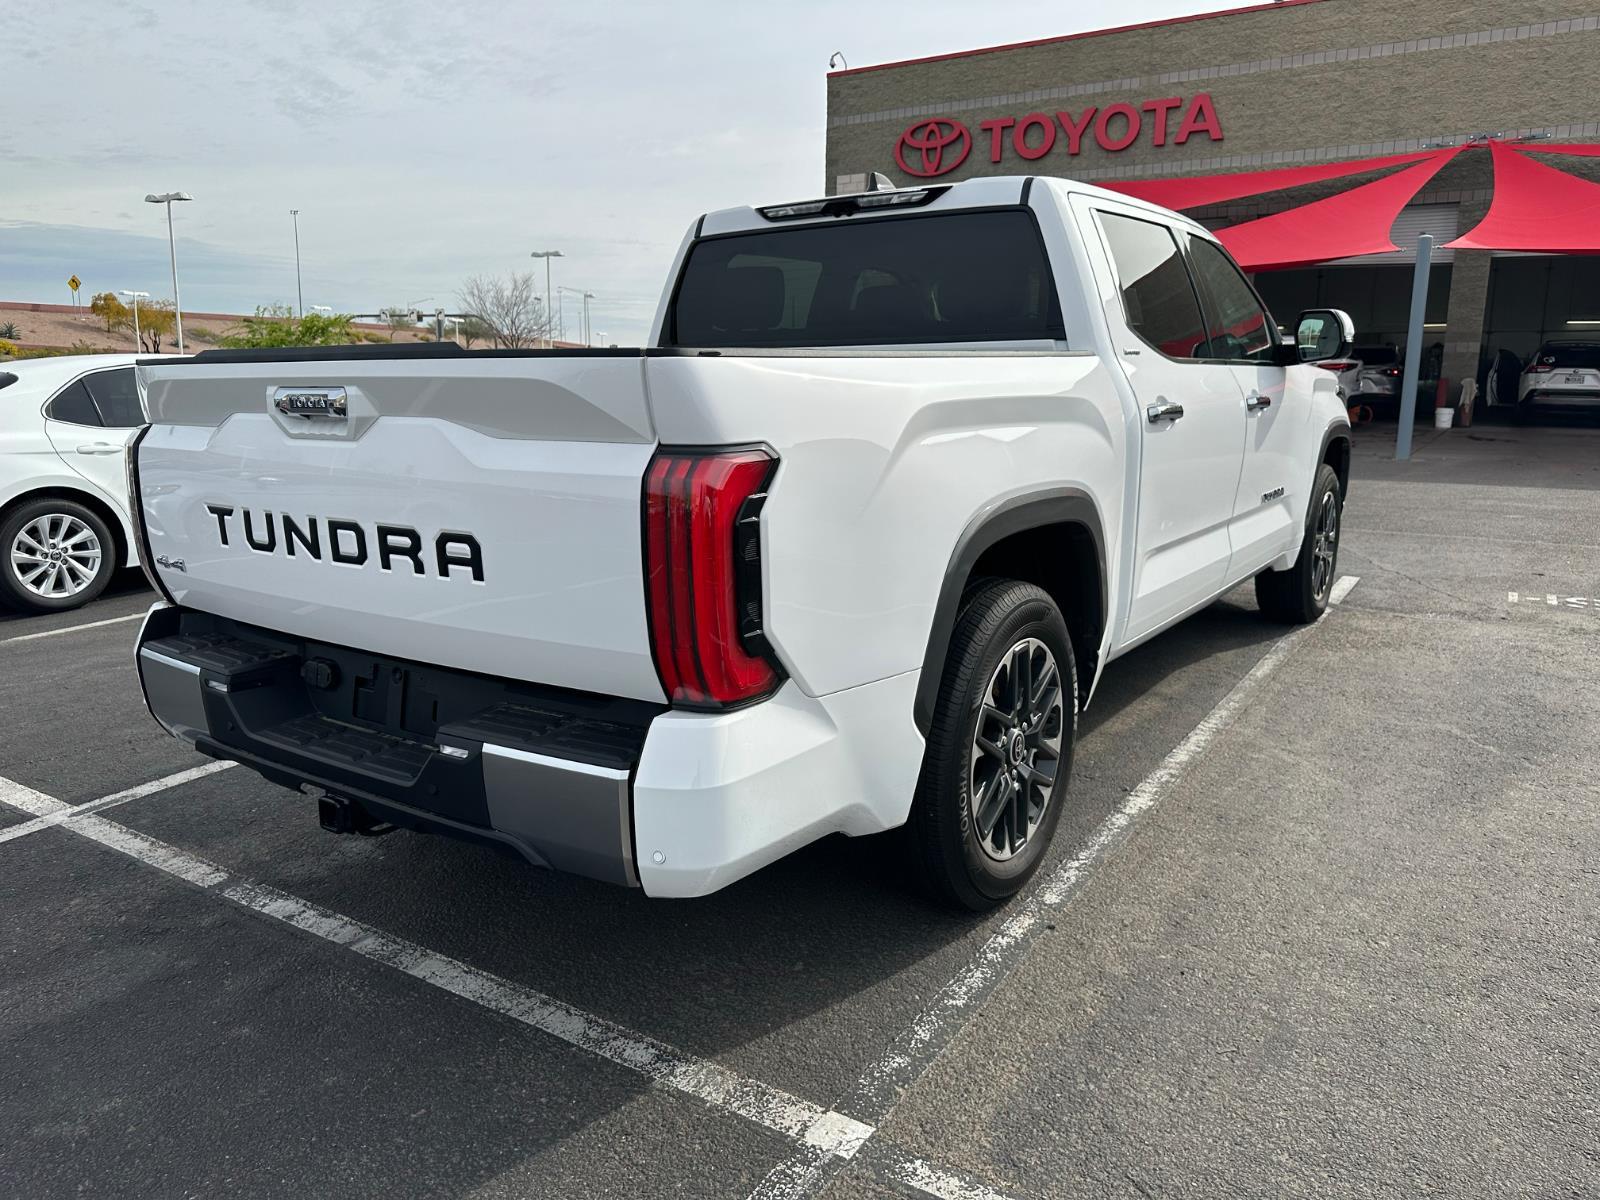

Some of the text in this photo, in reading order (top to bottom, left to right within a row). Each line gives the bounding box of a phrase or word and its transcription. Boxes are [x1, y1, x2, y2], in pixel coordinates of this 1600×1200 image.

[980, 93, 1224, 163] TOYOTA
[291, 396, 326, 408] TOYOTA
[204, 503, 485, 584] TUNDRA
